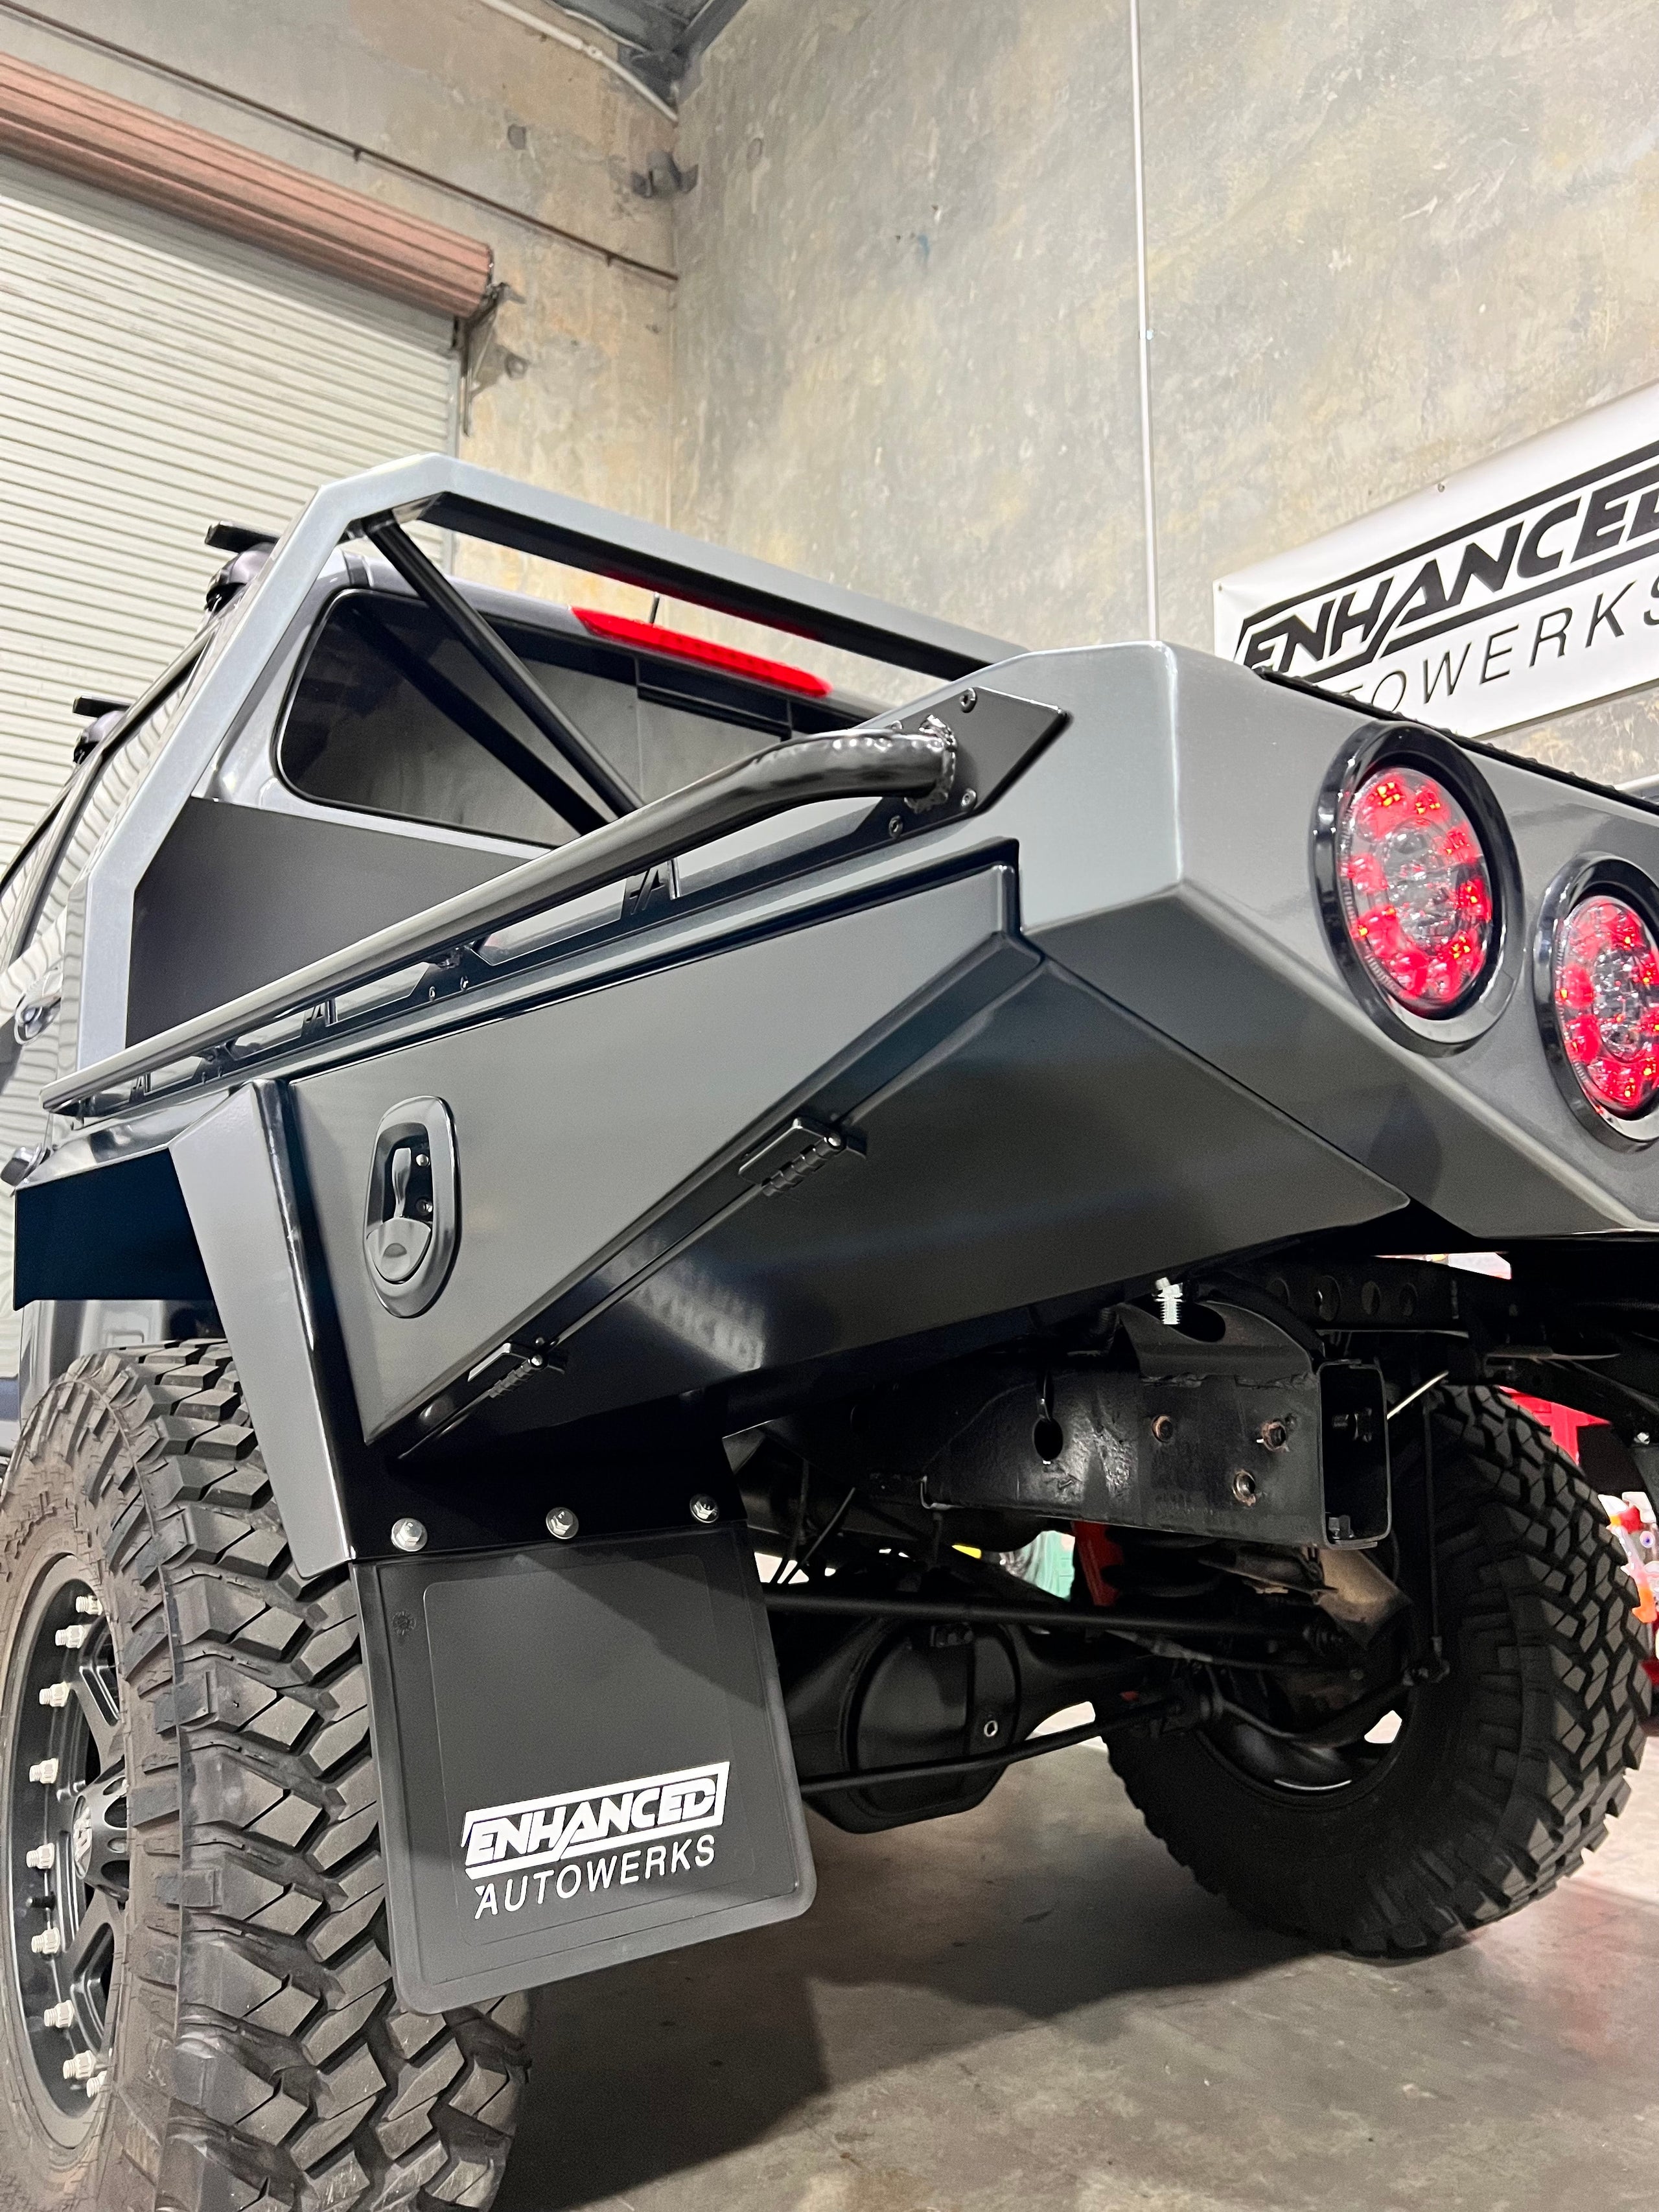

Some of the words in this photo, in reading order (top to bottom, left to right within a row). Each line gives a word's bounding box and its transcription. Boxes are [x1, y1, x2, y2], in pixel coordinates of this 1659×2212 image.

[1339, 576, 1659, 712] OWERK
[464, 1776, 717, 1867] ENHANCED
[474, 1834, 715, 1919] AUTOWERKS
